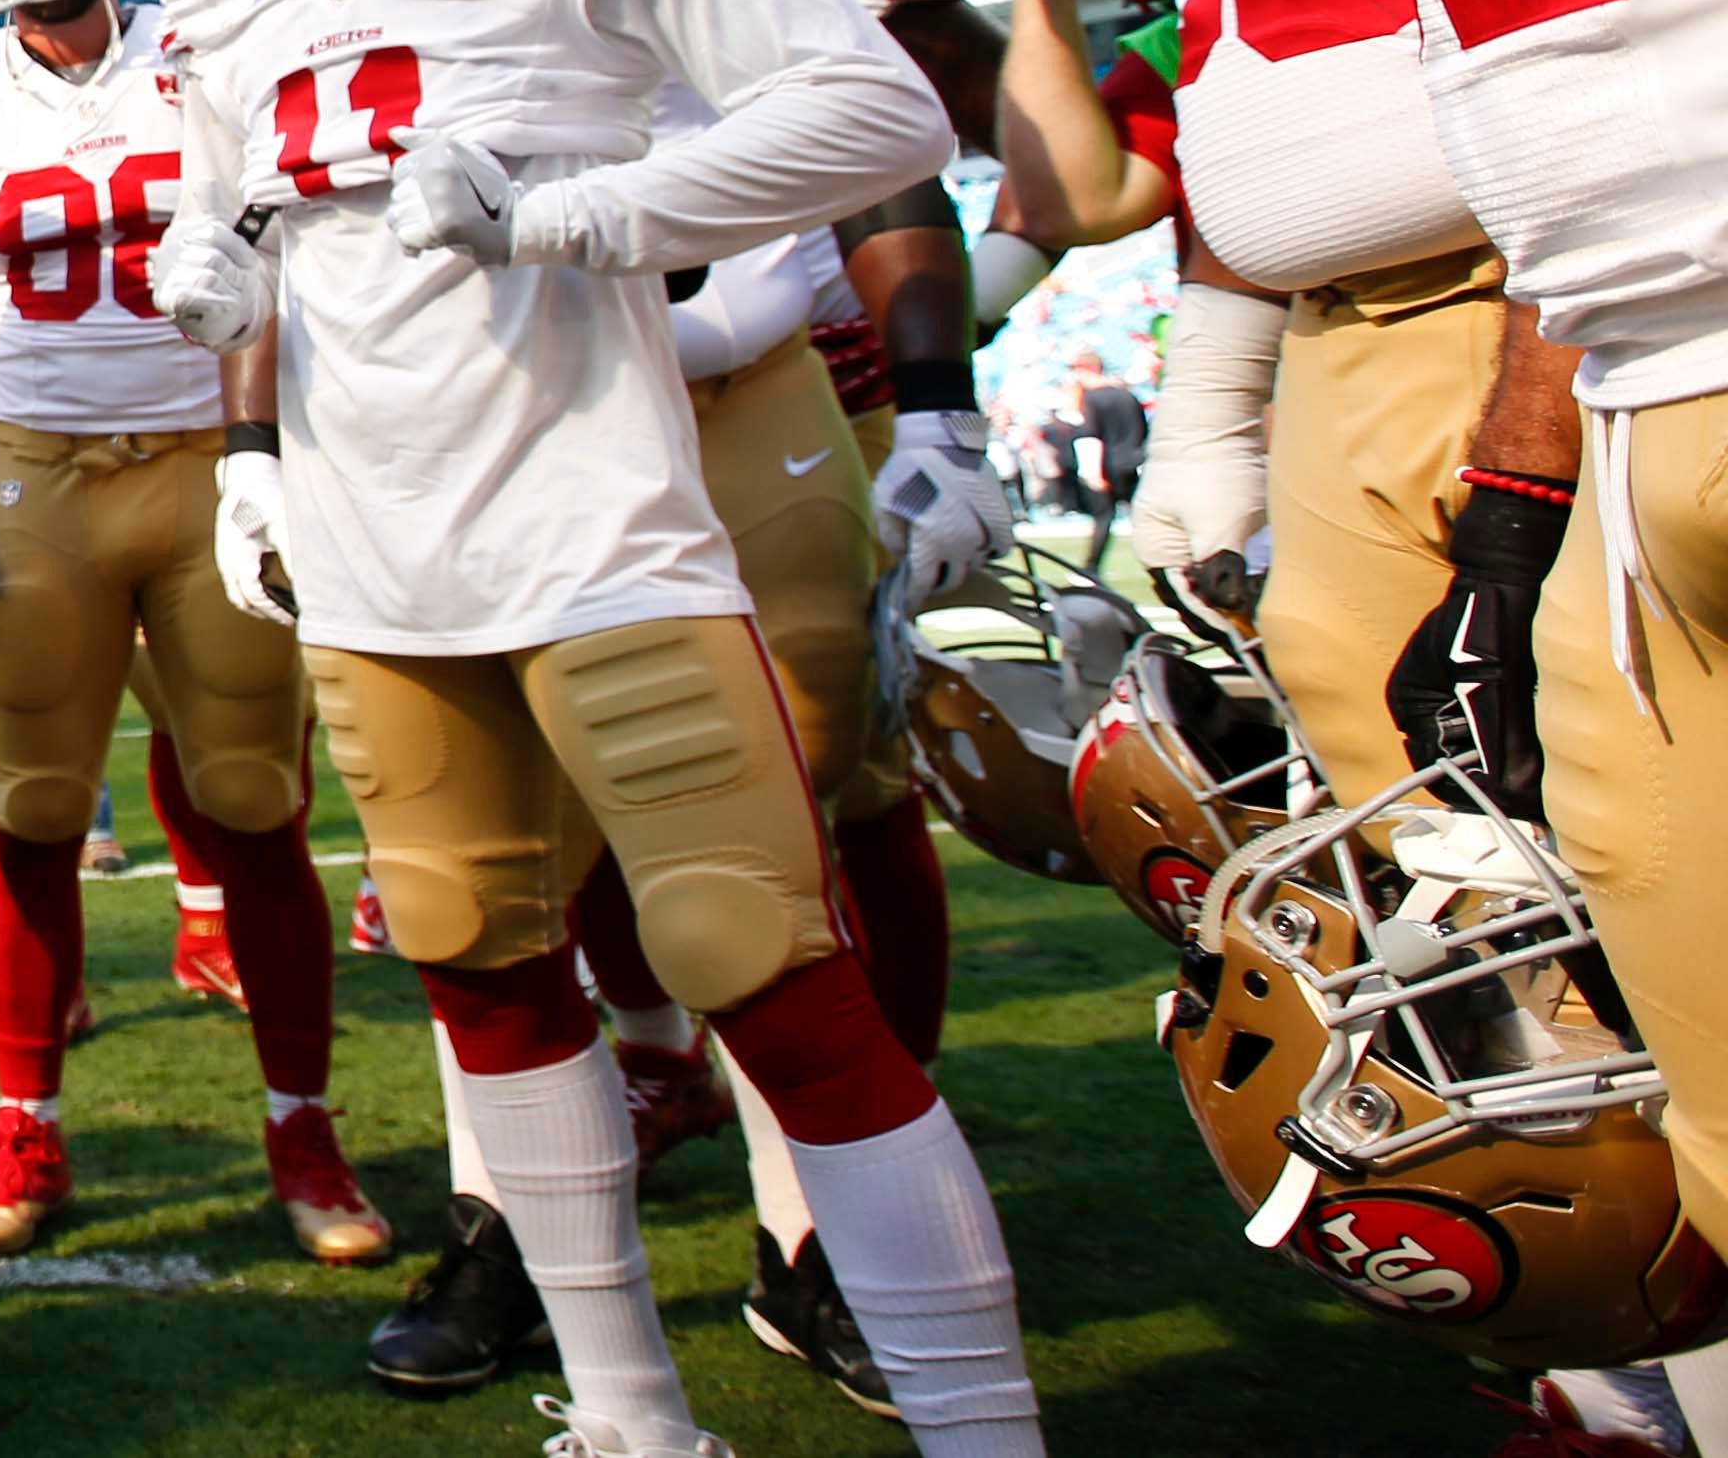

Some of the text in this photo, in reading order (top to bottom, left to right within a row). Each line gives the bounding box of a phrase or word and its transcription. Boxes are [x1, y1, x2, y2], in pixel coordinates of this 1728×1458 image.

[304, 26, 385, 56] 49ERS
[273, 45, 423, 198] 11
[1321, 1211, 1473, 1313] SF
